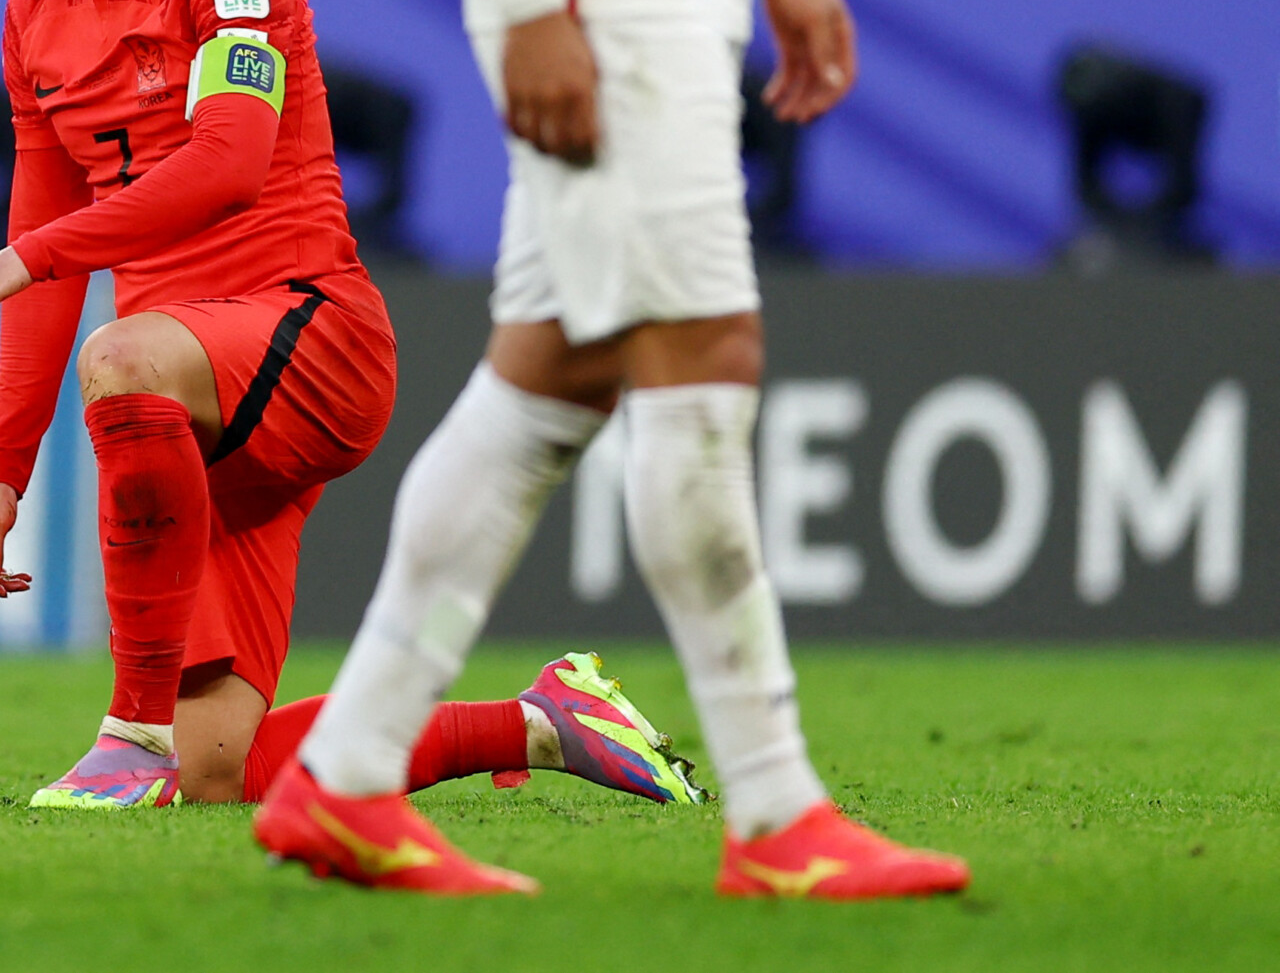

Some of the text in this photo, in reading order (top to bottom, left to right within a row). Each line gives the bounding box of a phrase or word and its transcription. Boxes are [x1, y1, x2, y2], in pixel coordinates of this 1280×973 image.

[235, 48, 259, 60] AFC
[233, 56, 271, 75] LIVE
[138, 91, 174, 109] KOREA
[93, 128, 133, 186] 7
